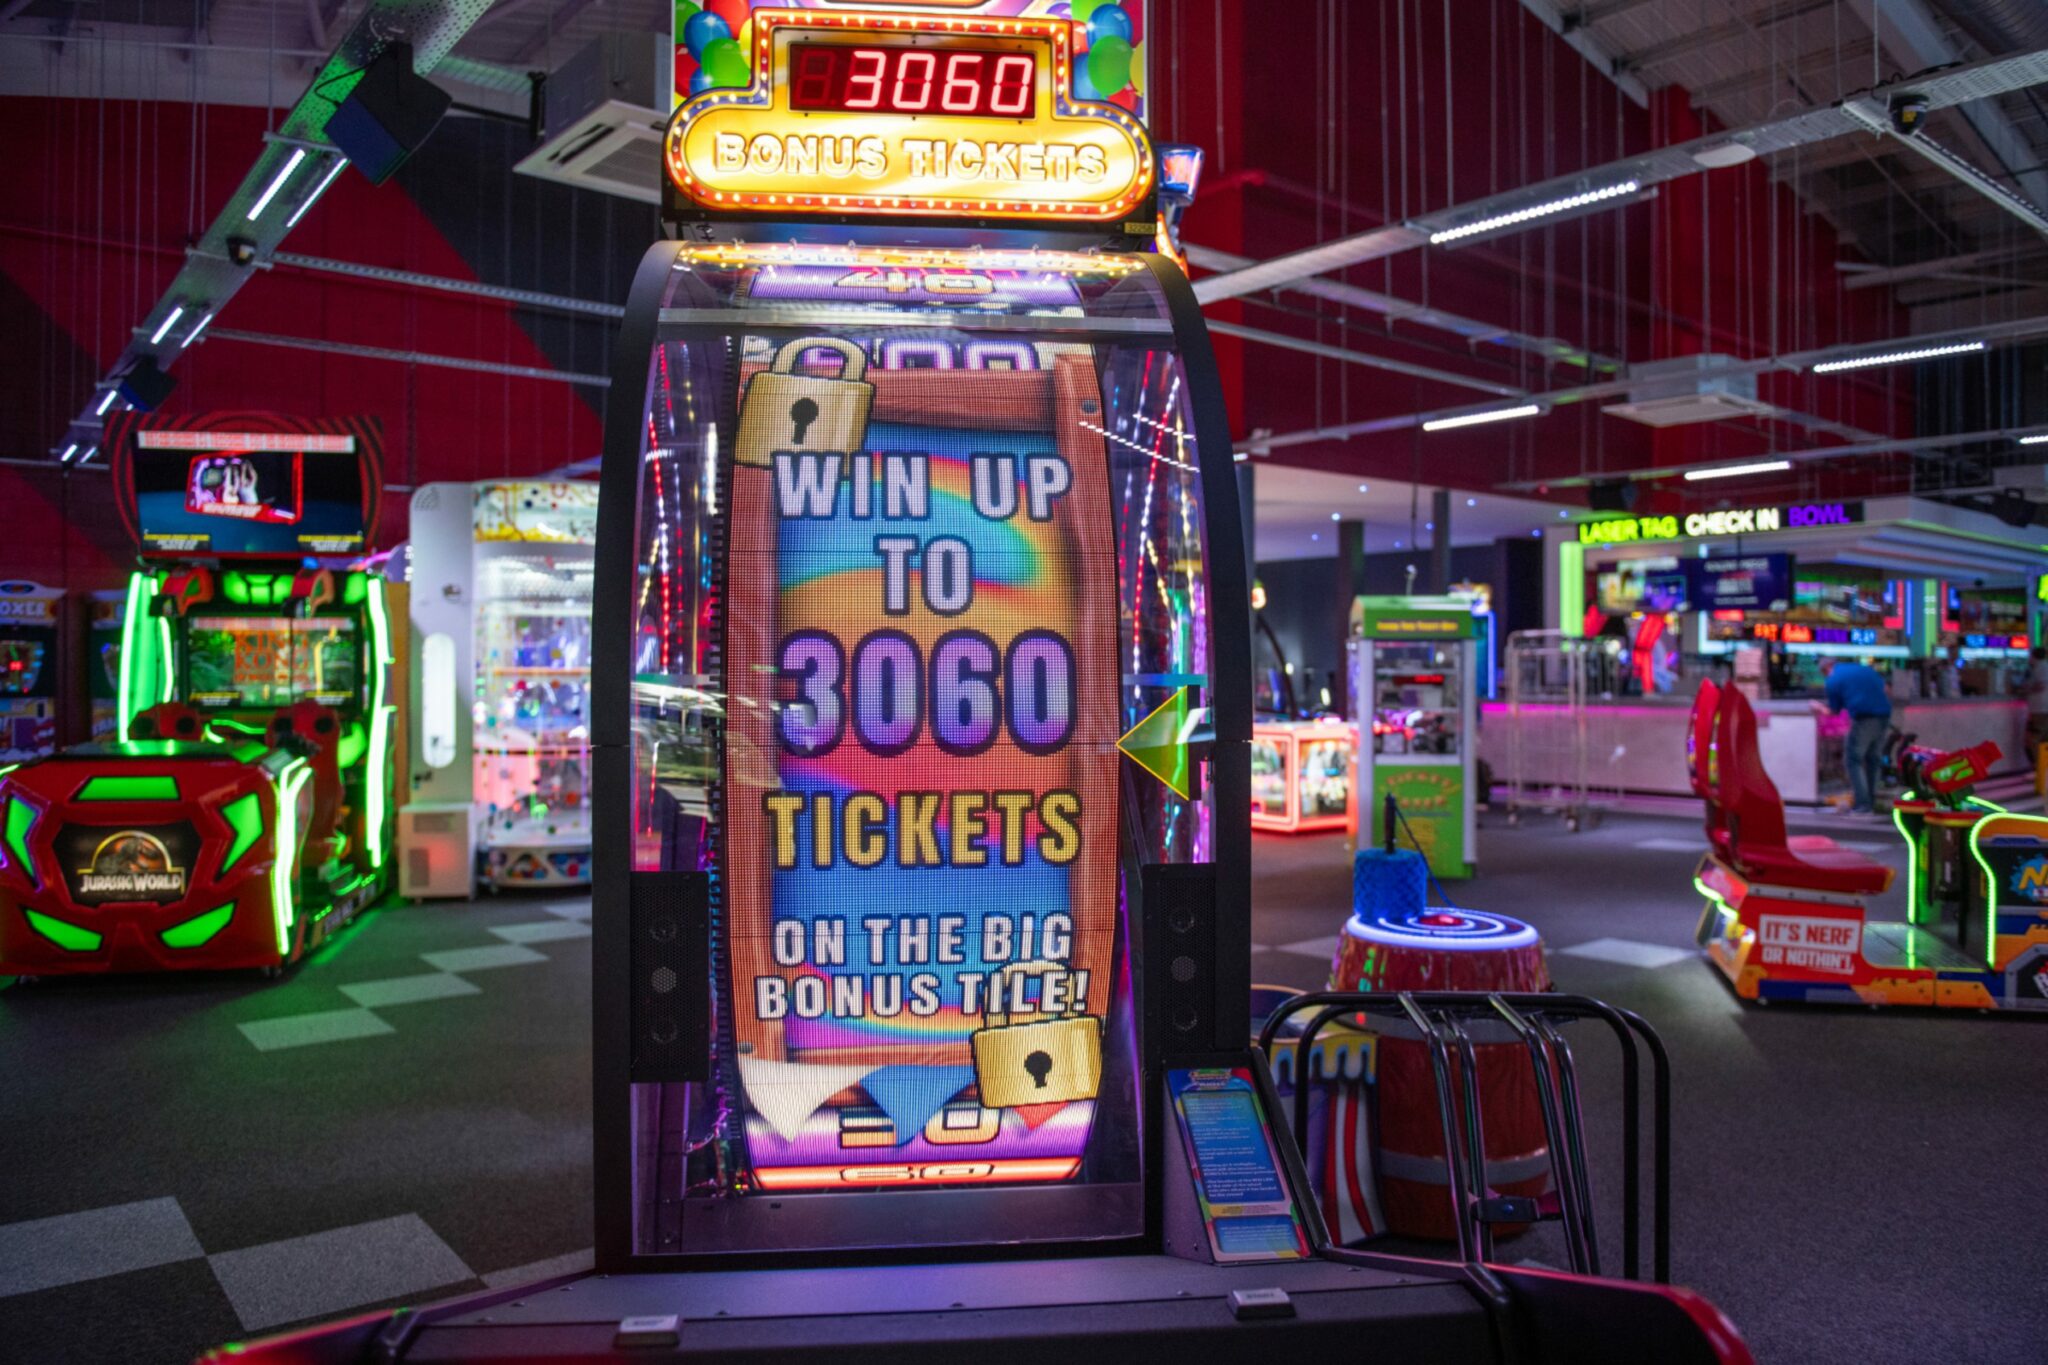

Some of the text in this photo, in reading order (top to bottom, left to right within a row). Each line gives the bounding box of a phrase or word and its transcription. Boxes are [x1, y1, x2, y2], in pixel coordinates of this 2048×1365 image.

[845, 50, 1032, 113] 3060
[716, 132, 1106, 183] BONUS TICKETS
[773, 452, 1072, 521] WIN UP
[1579, 504, 1849, 544] LASER TAG CHECK IN BOWL
[876, 536, 973, 614] TO
[779, 632, 1074, 752] 3060
[766, 793, 1081, 868] TICKETS
[81, 874, 181, 892] JURASSIC WORLD
[774, 914, 1073, 966] ON THE BIG
[1762, 945, 1783, 965] OR
[1766, 921, 1854, 945] IT'S NERF
[756, 970, 1090, 1019] BONUS TILE!
